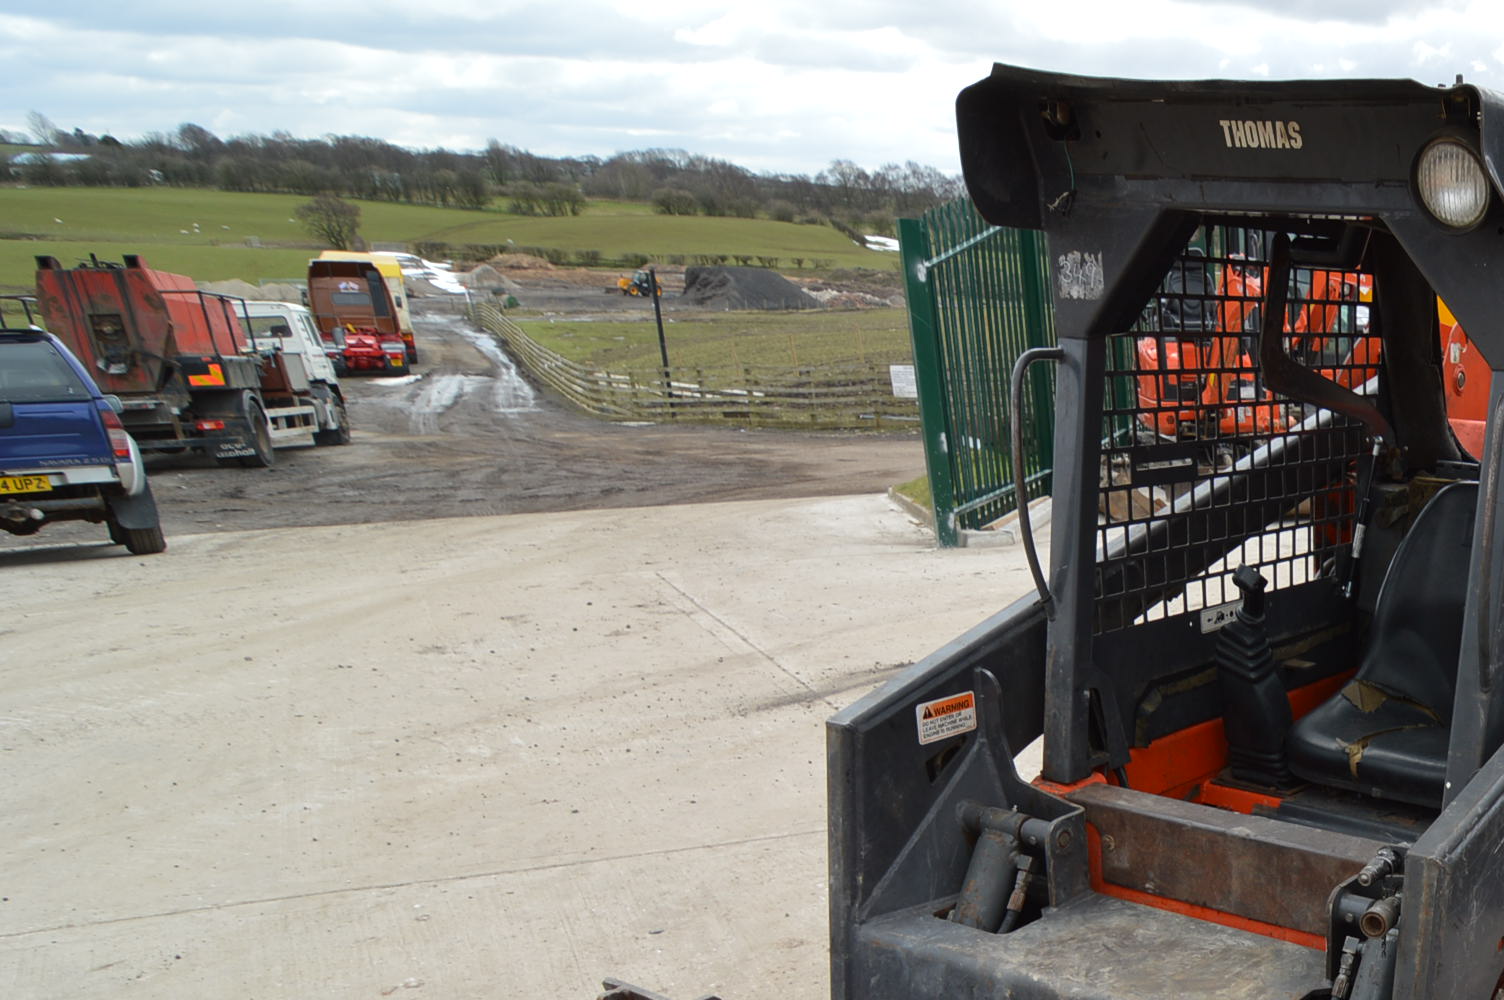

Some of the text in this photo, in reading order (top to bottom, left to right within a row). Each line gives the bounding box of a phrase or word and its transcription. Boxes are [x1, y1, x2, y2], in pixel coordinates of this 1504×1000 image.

[1219, 120, 1303, 149] THOMAS
[14, 477, 46, 491] UPZ
[934, 699, 970, 717] WARNING
